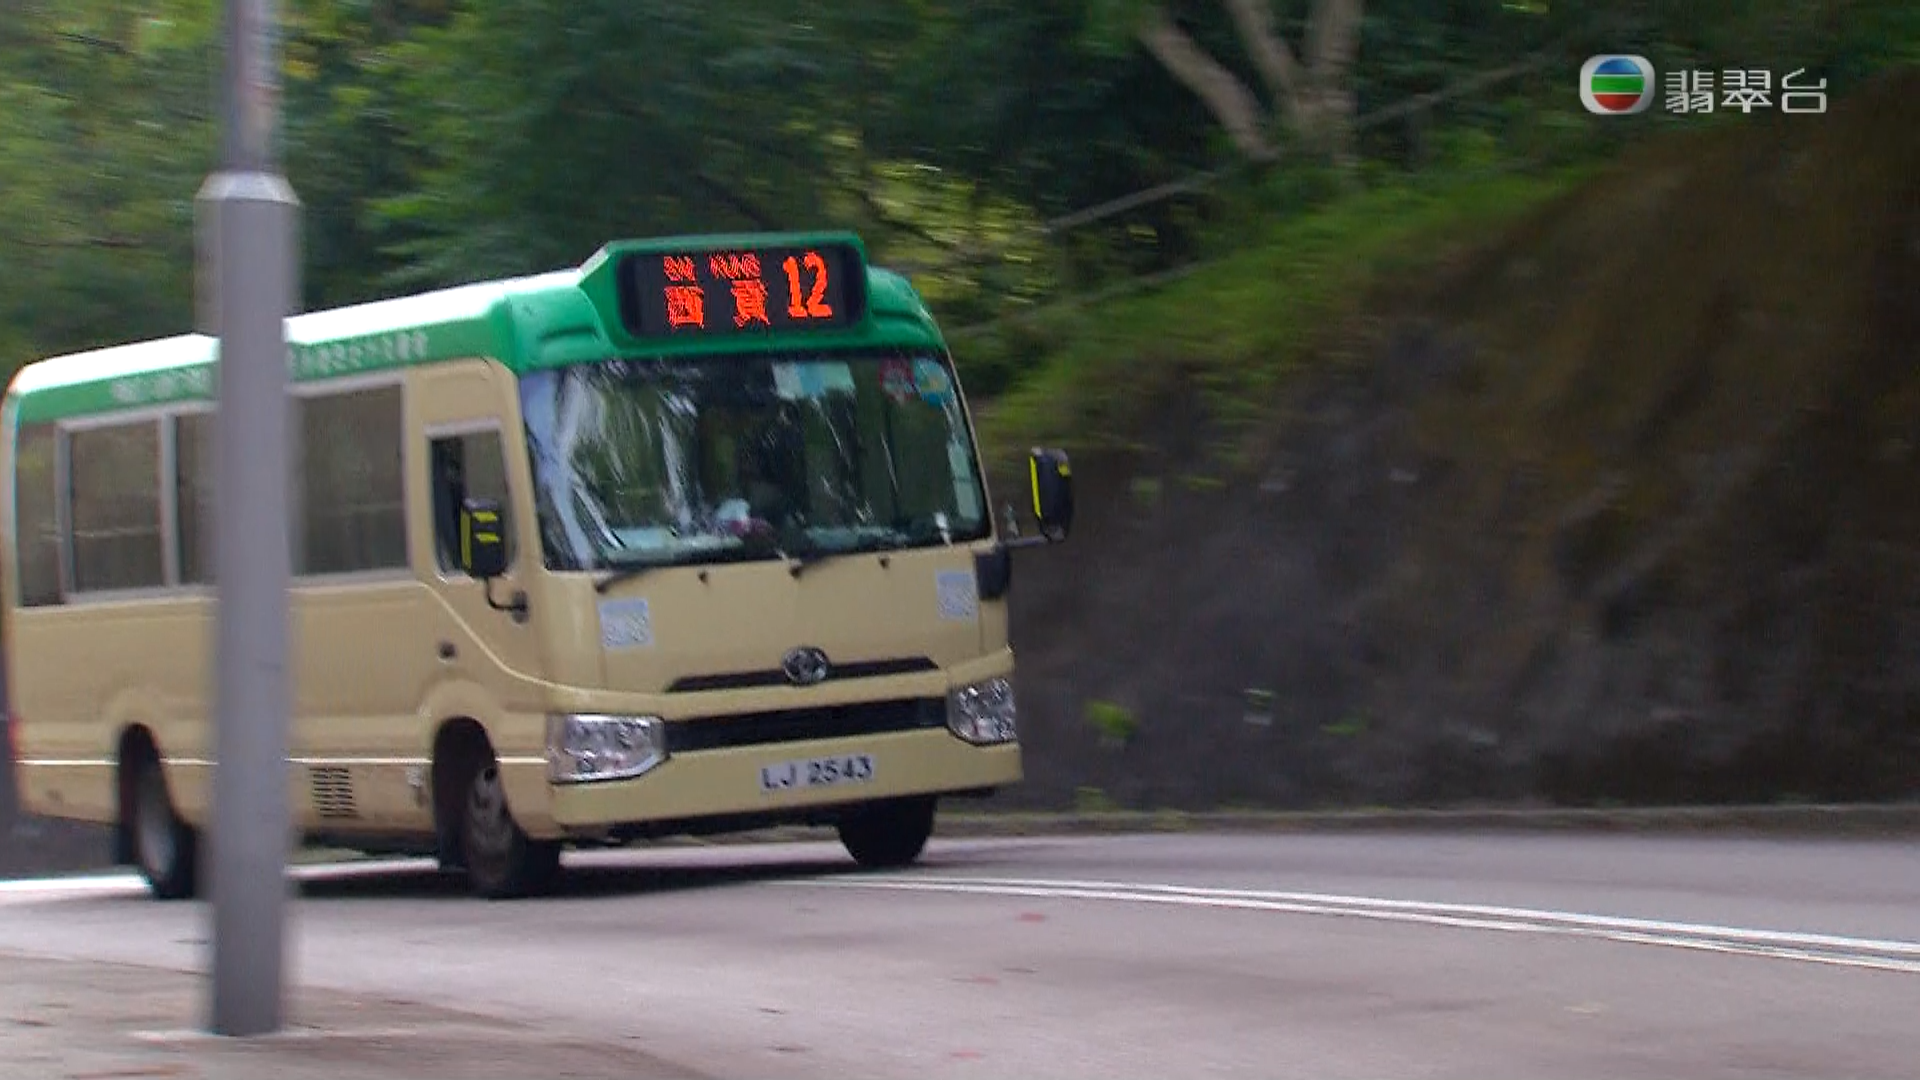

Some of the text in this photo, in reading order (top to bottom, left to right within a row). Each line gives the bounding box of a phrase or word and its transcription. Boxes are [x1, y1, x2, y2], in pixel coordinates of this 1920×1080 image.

[782, 250, 833, 319] 12
[761, 755, 873, 789] LJ 2543
